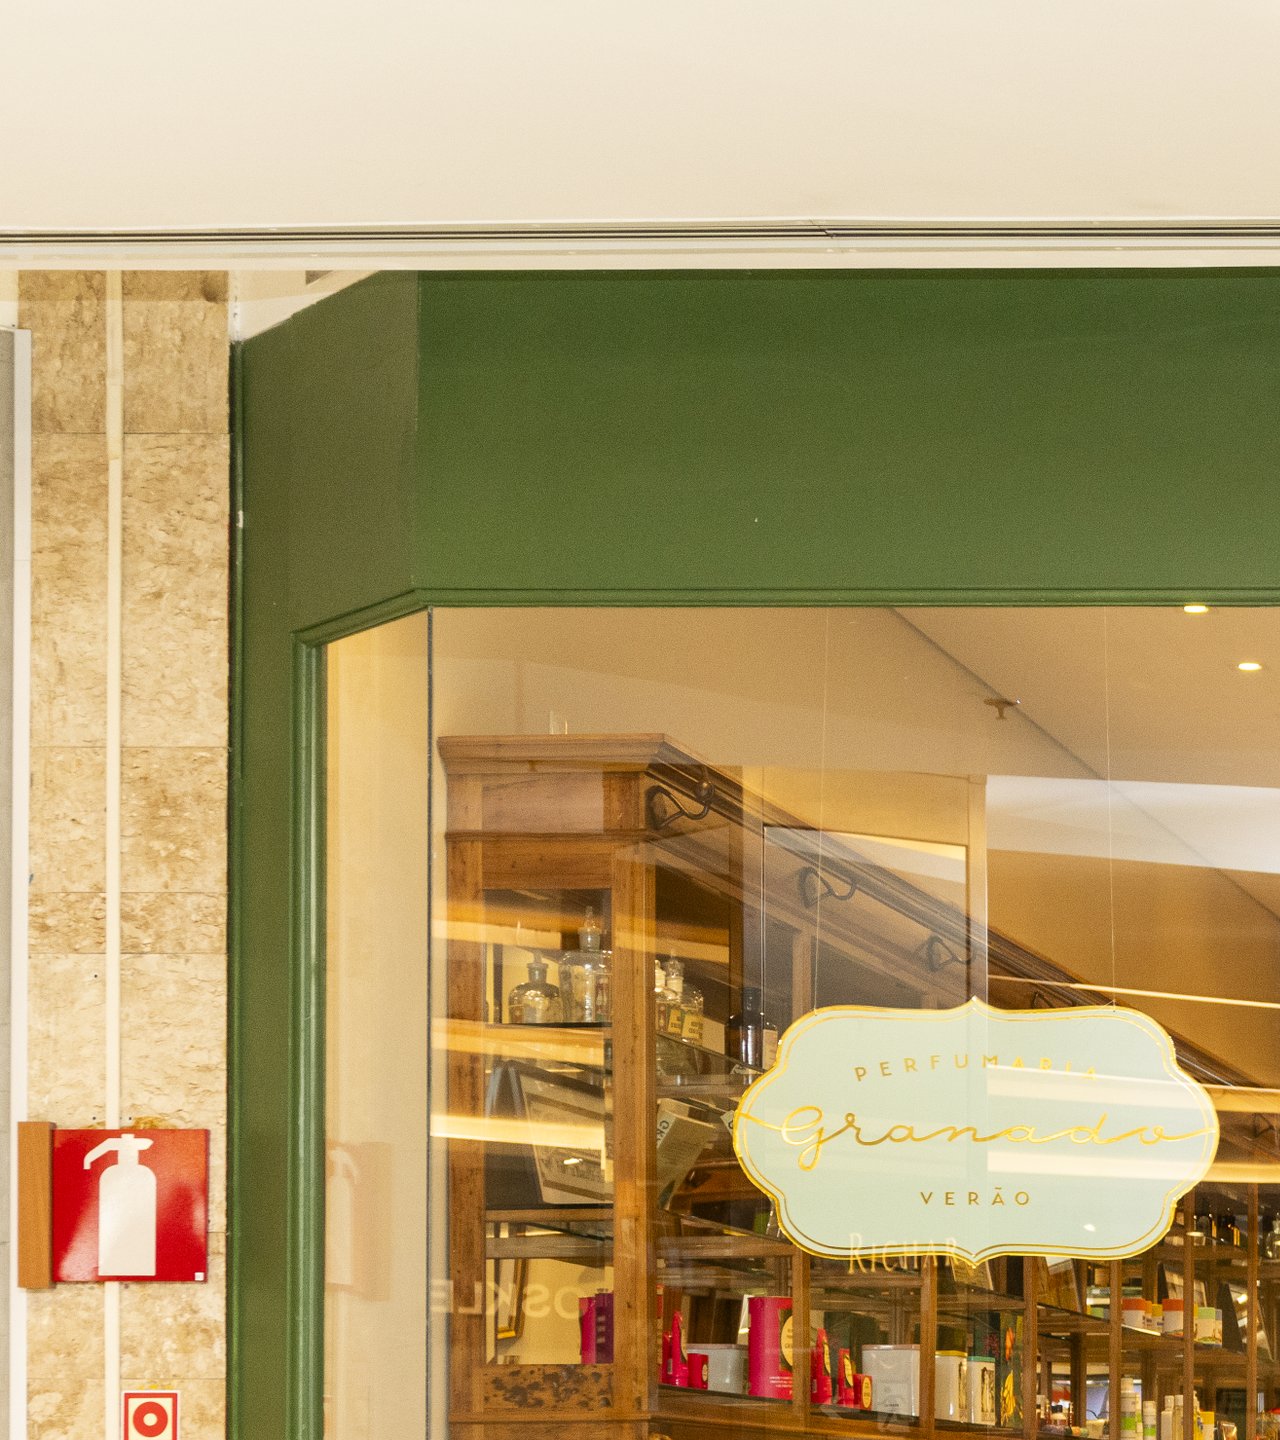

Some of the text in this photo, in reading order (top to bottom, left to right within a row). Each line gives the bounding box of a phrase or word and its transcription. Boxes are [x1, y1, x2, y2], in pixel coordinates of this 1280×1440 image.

[853, 1053, 1099, 1083] PERFUMARIA
[736, 1104, 1215, 1172] Granado
[920, 1186, 1031, 1207] VERÃO
